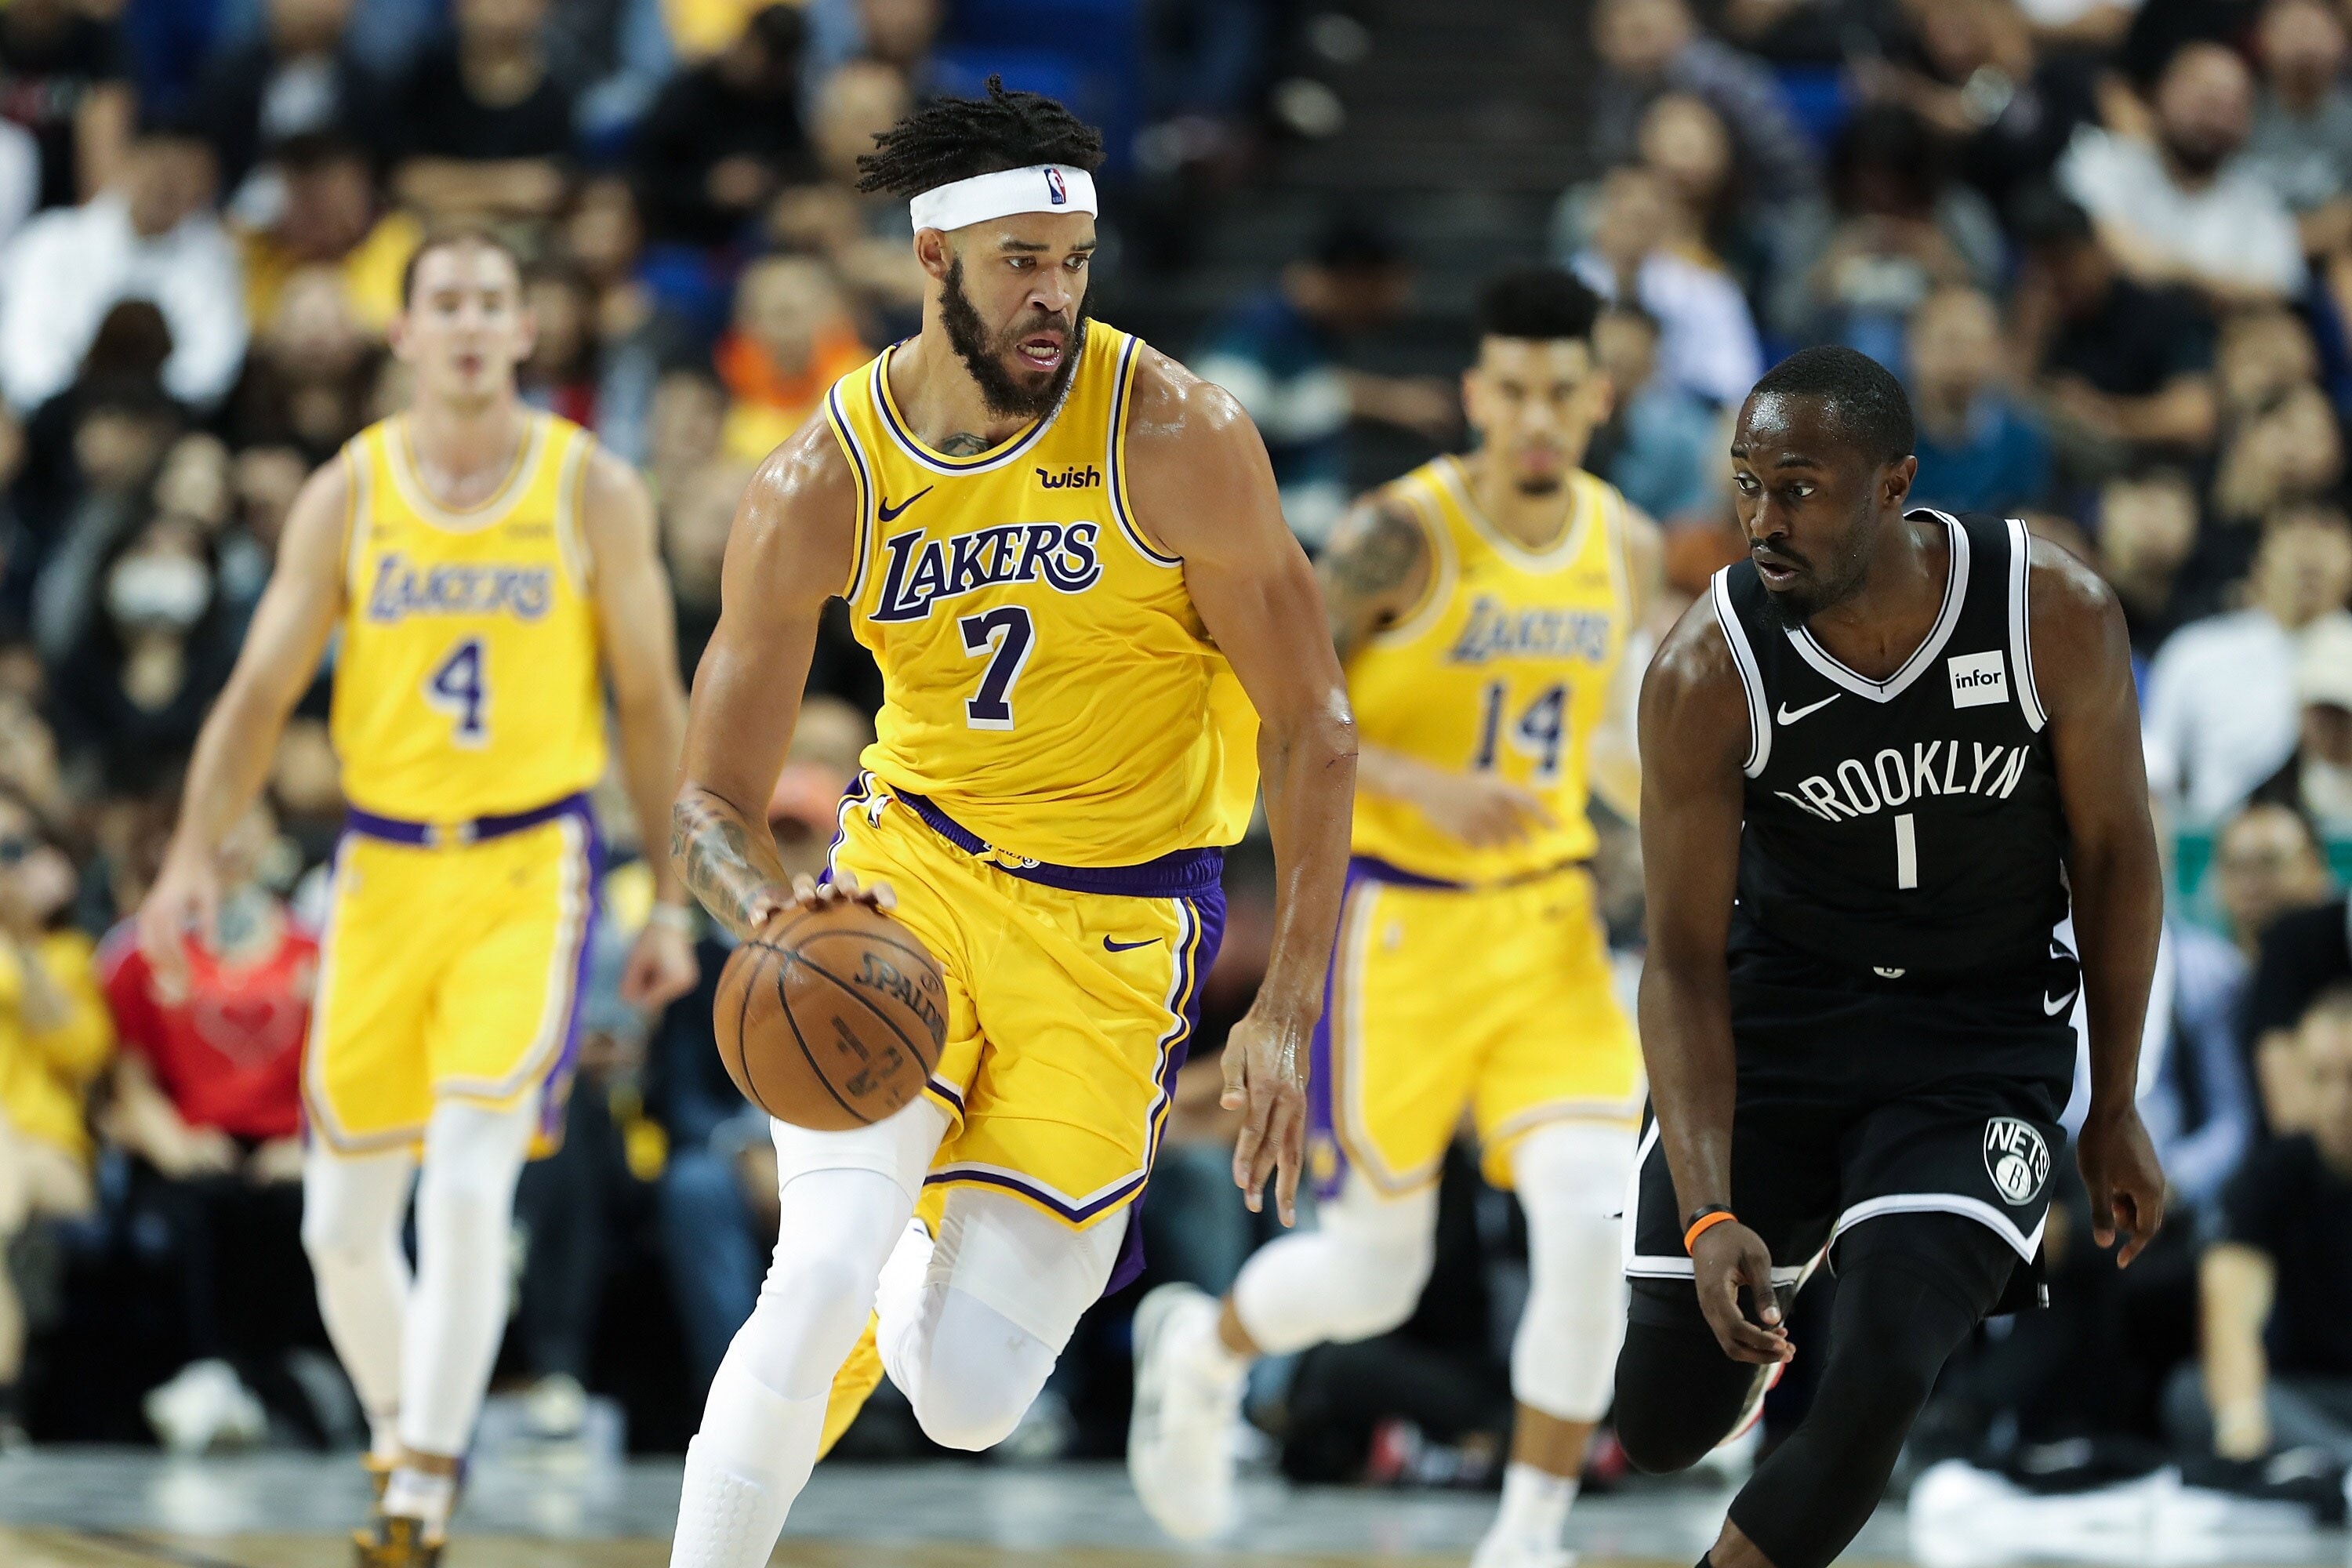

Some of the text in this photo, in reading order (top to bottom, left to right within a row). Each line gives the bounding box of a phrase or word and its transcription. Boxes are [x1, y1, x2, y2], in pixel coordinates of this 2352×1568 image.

[1036, 465, 1100, 489] wish
[367, 552, 556, 624] LAKERS
[867, 519, 1105, 624] LAKERS
[426, 637, 492, 747] 4
[956, 604, 1036, 731] 7
[1955, 668, 2002, 690] infor
[1476, 681, 1570, 783] 14
[1894, 812, 1918, 890] 1
[1987, 1122, 2048, 1185] NETS
[2007, 1162, 2024, 1192] B
